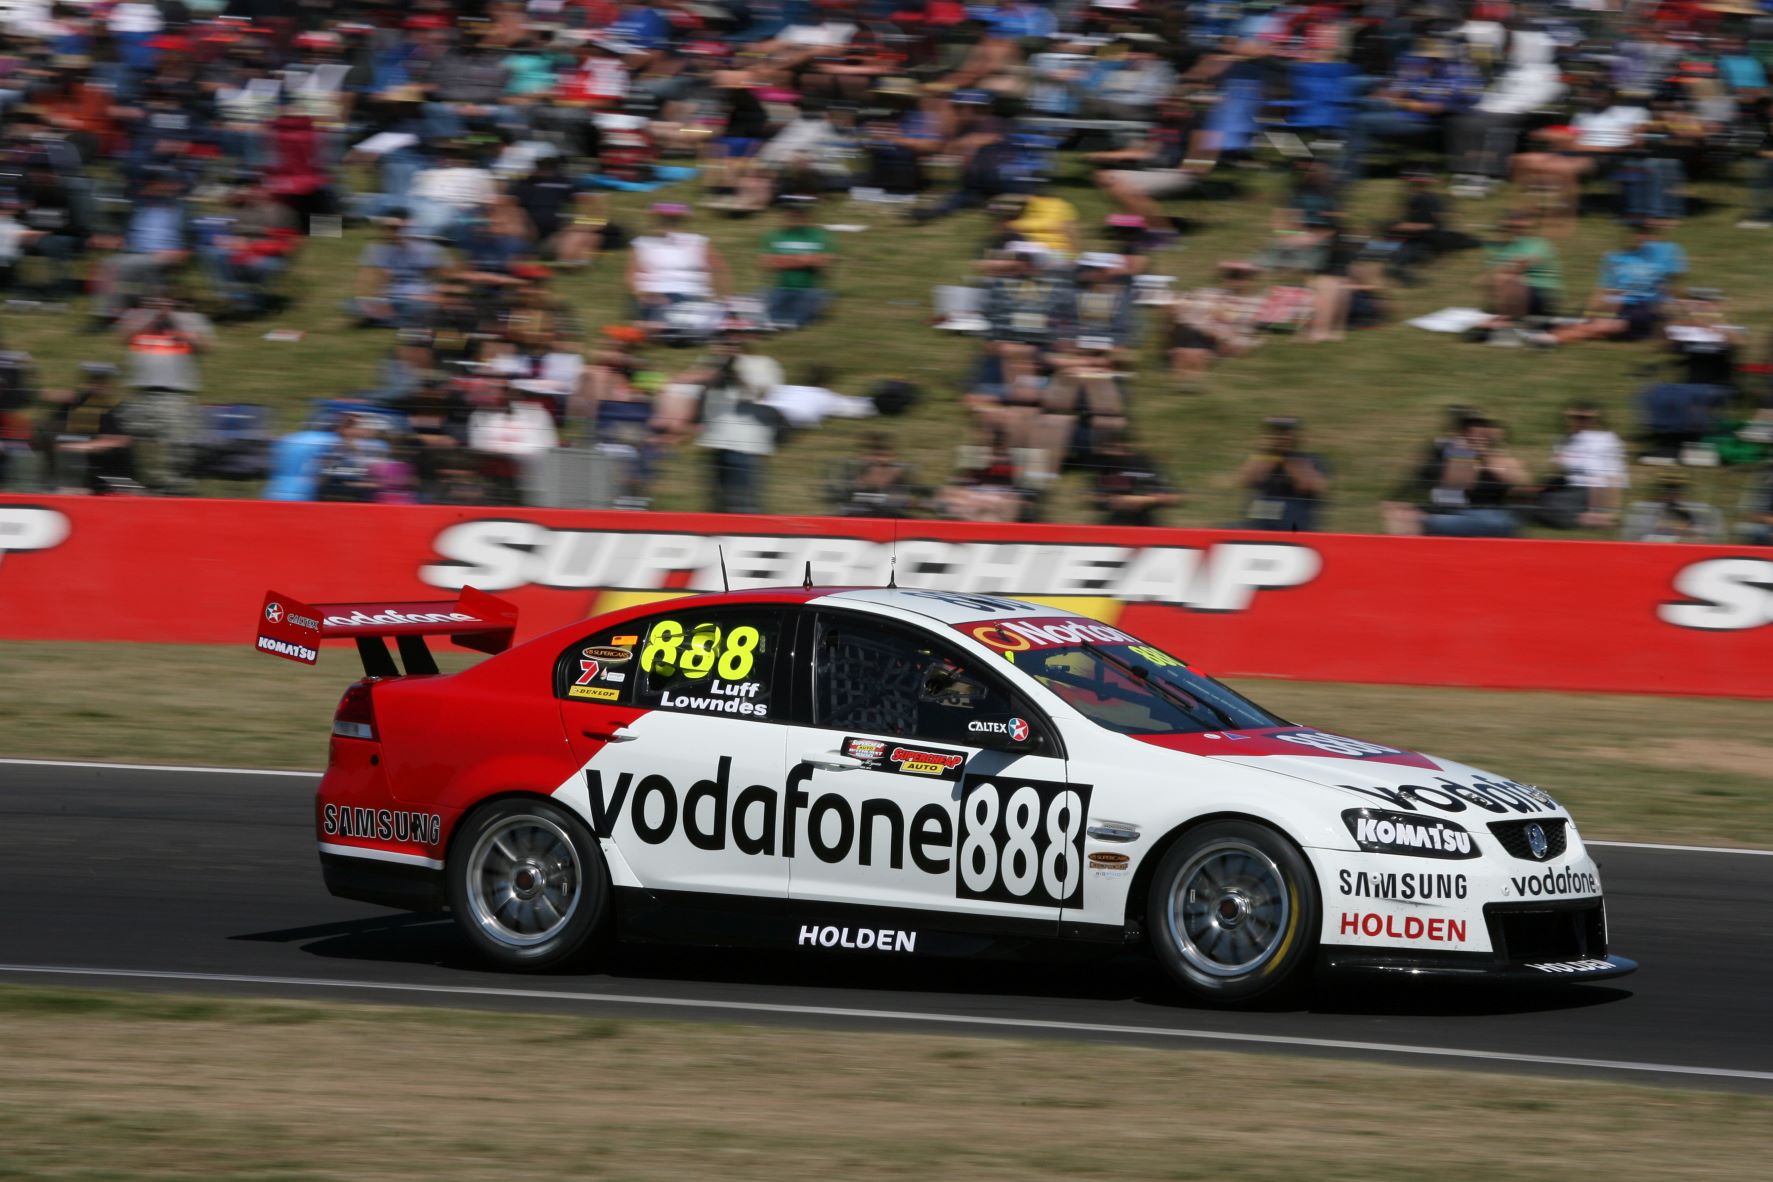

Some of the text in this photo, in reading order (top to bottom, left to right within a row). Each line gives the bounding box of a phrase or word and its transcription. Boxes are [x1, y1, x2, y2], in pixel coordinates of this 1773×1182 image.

[420, 519, 1322, 611] SUPERCHEAP
[323, 609, 482, 627] vodafone
[1001, 619, 1143, 645] Norton
[258, 636, 316, 661] KOMATSU
[641, 620, 759, 681] 888
[575, 659, 600, 685] 7
[579, 688, 615, 697] DUNLOP
[711, 679, 760, 698] Luff
[660, 690, 767, 716] Lowndes
[968, 720, 1008, 734] CALTEX
[890, 747, 963, 769] SUPERCHEAP
[907, 763, 938, 771] AUTO
[323, 803, 441, 846] SAMSUNG
[586, 756, 953, 874] vodafone
[962, 782, 1082, 901] 888
[1357, 818, 1471, 854] KOMATSU
[1339, 868, 1468, 900] SAMSUNG
[1510, 865, 1597, 897] vodafone
[798, 925, 917, 952] HOLDEN
[1340, 912, 1467, 943] HOLDEN
